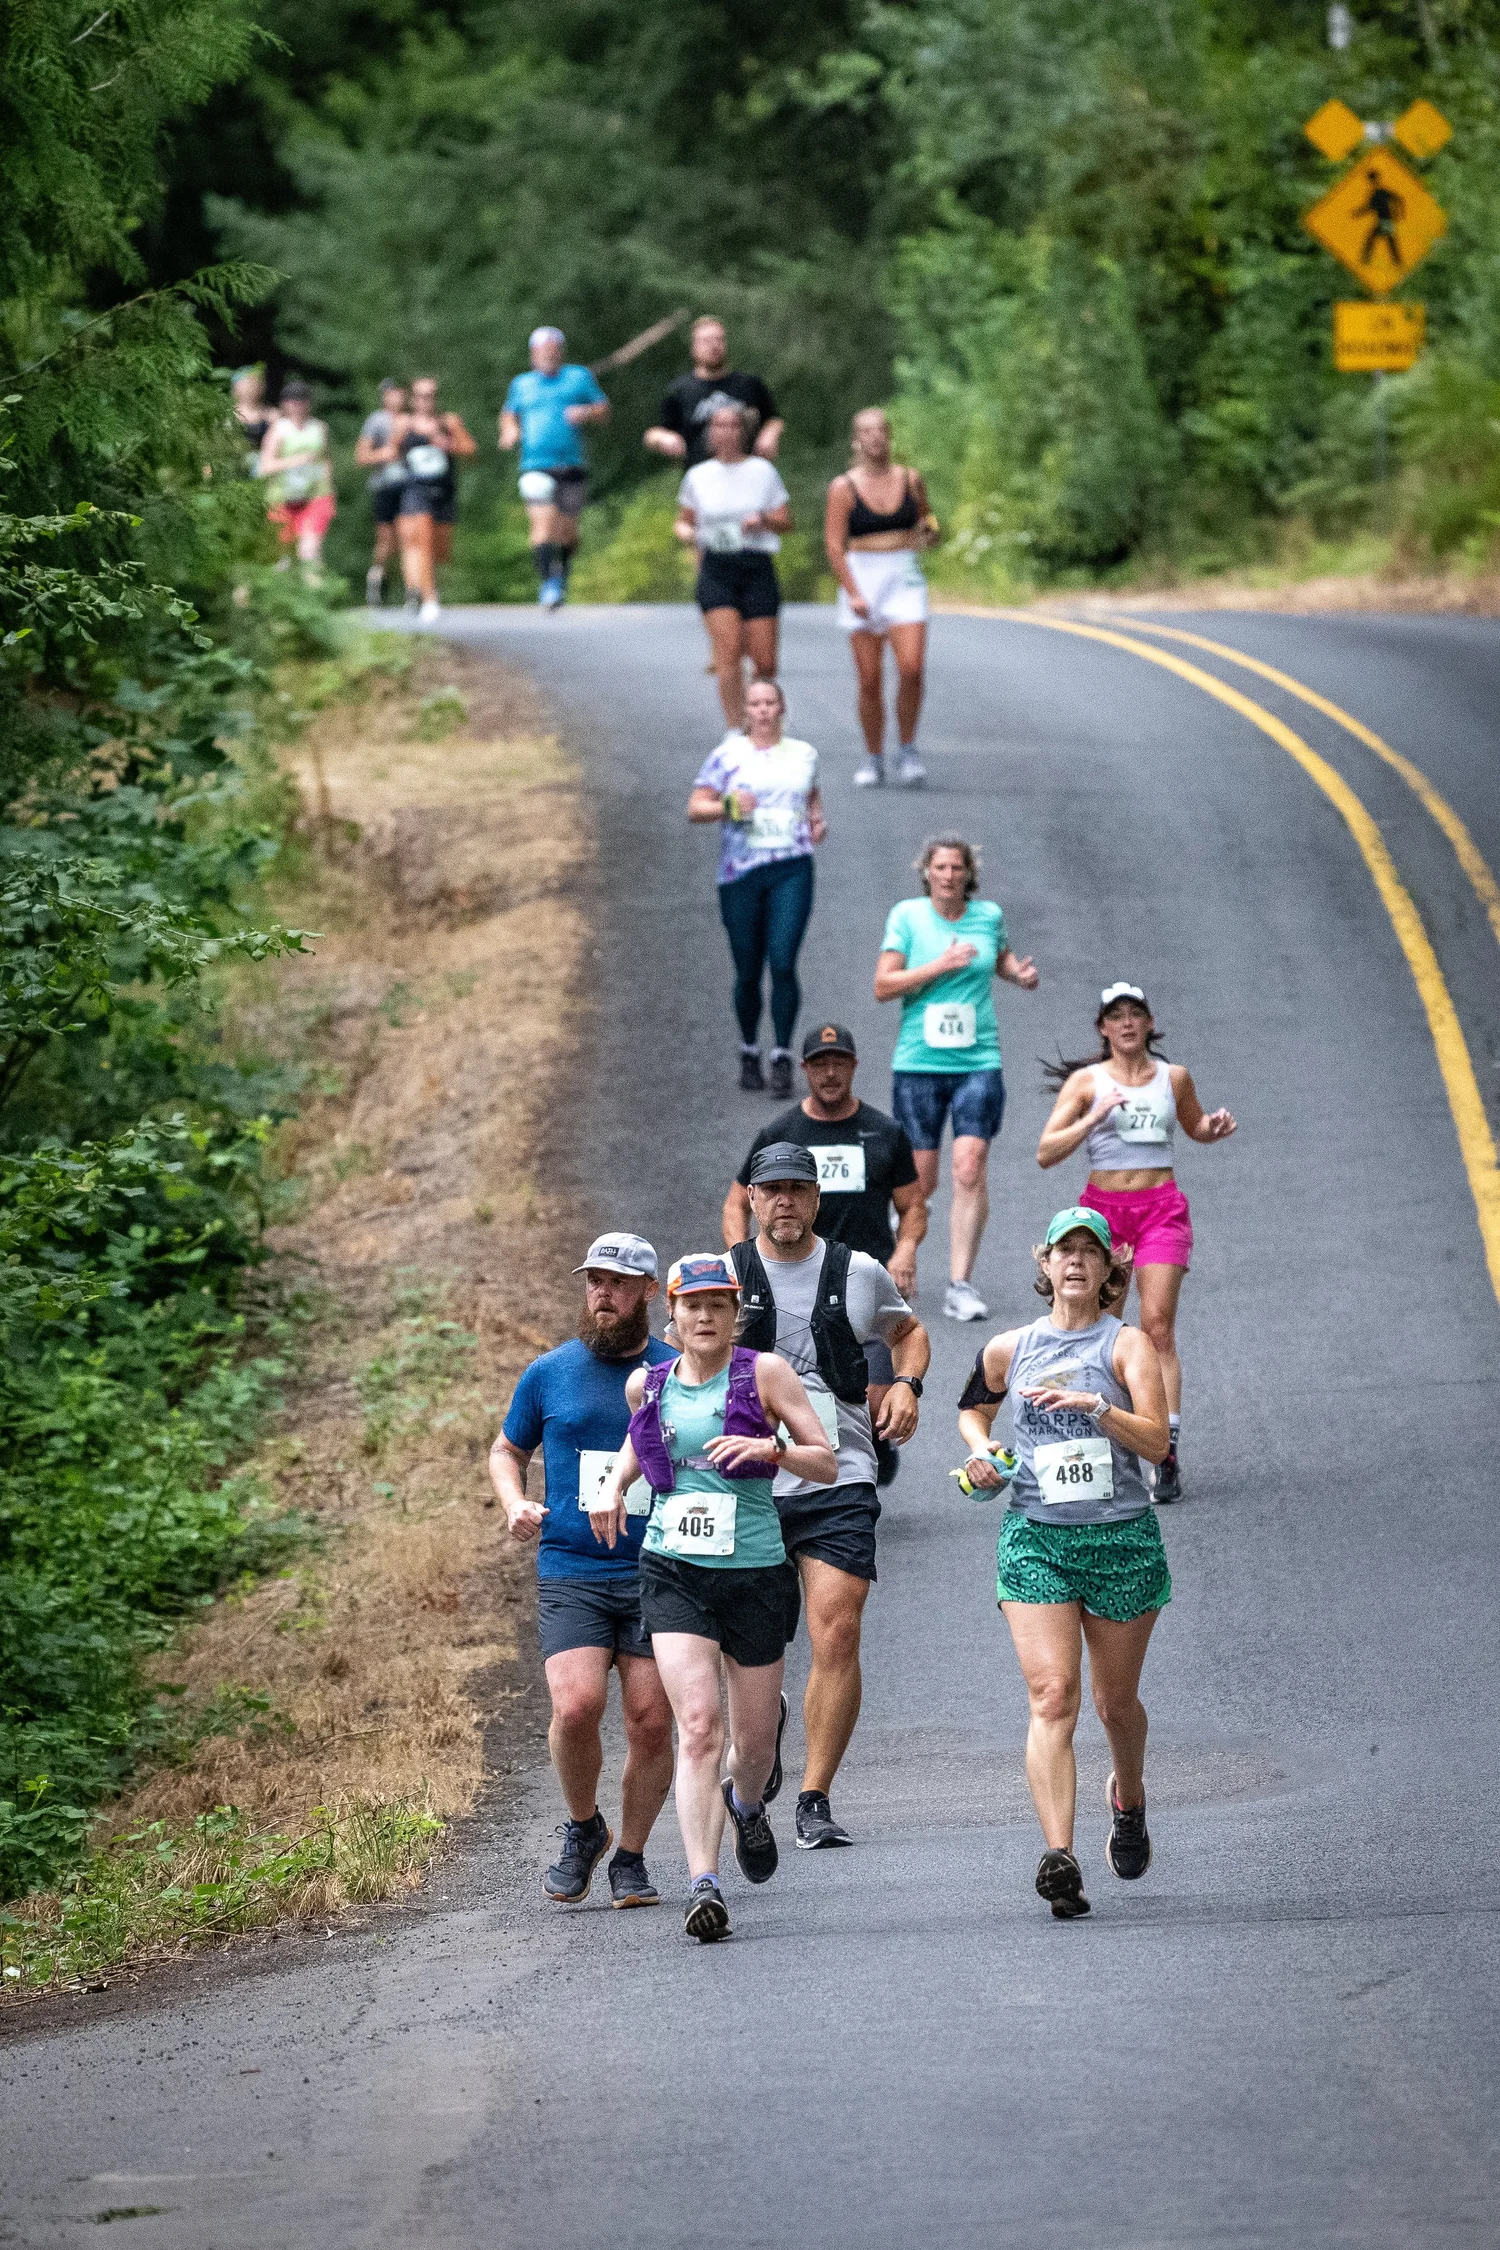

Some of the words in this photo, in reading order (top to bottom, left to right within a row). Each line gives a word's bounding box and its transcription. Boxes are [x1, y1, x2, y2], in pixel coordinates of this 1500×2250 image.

[939, 1021, 964, 1036] 414
[1130, 1114, 1157, 1129] 277
[821, 1163, 849, 1179] 276
[1026, 1412, 1091, 1426] CORPS
[1028, 1427, 1092, 1437] MARATHON
[1056, 1462, 1094, 1485] 488
[678, 1516, 715, 1538] 405
